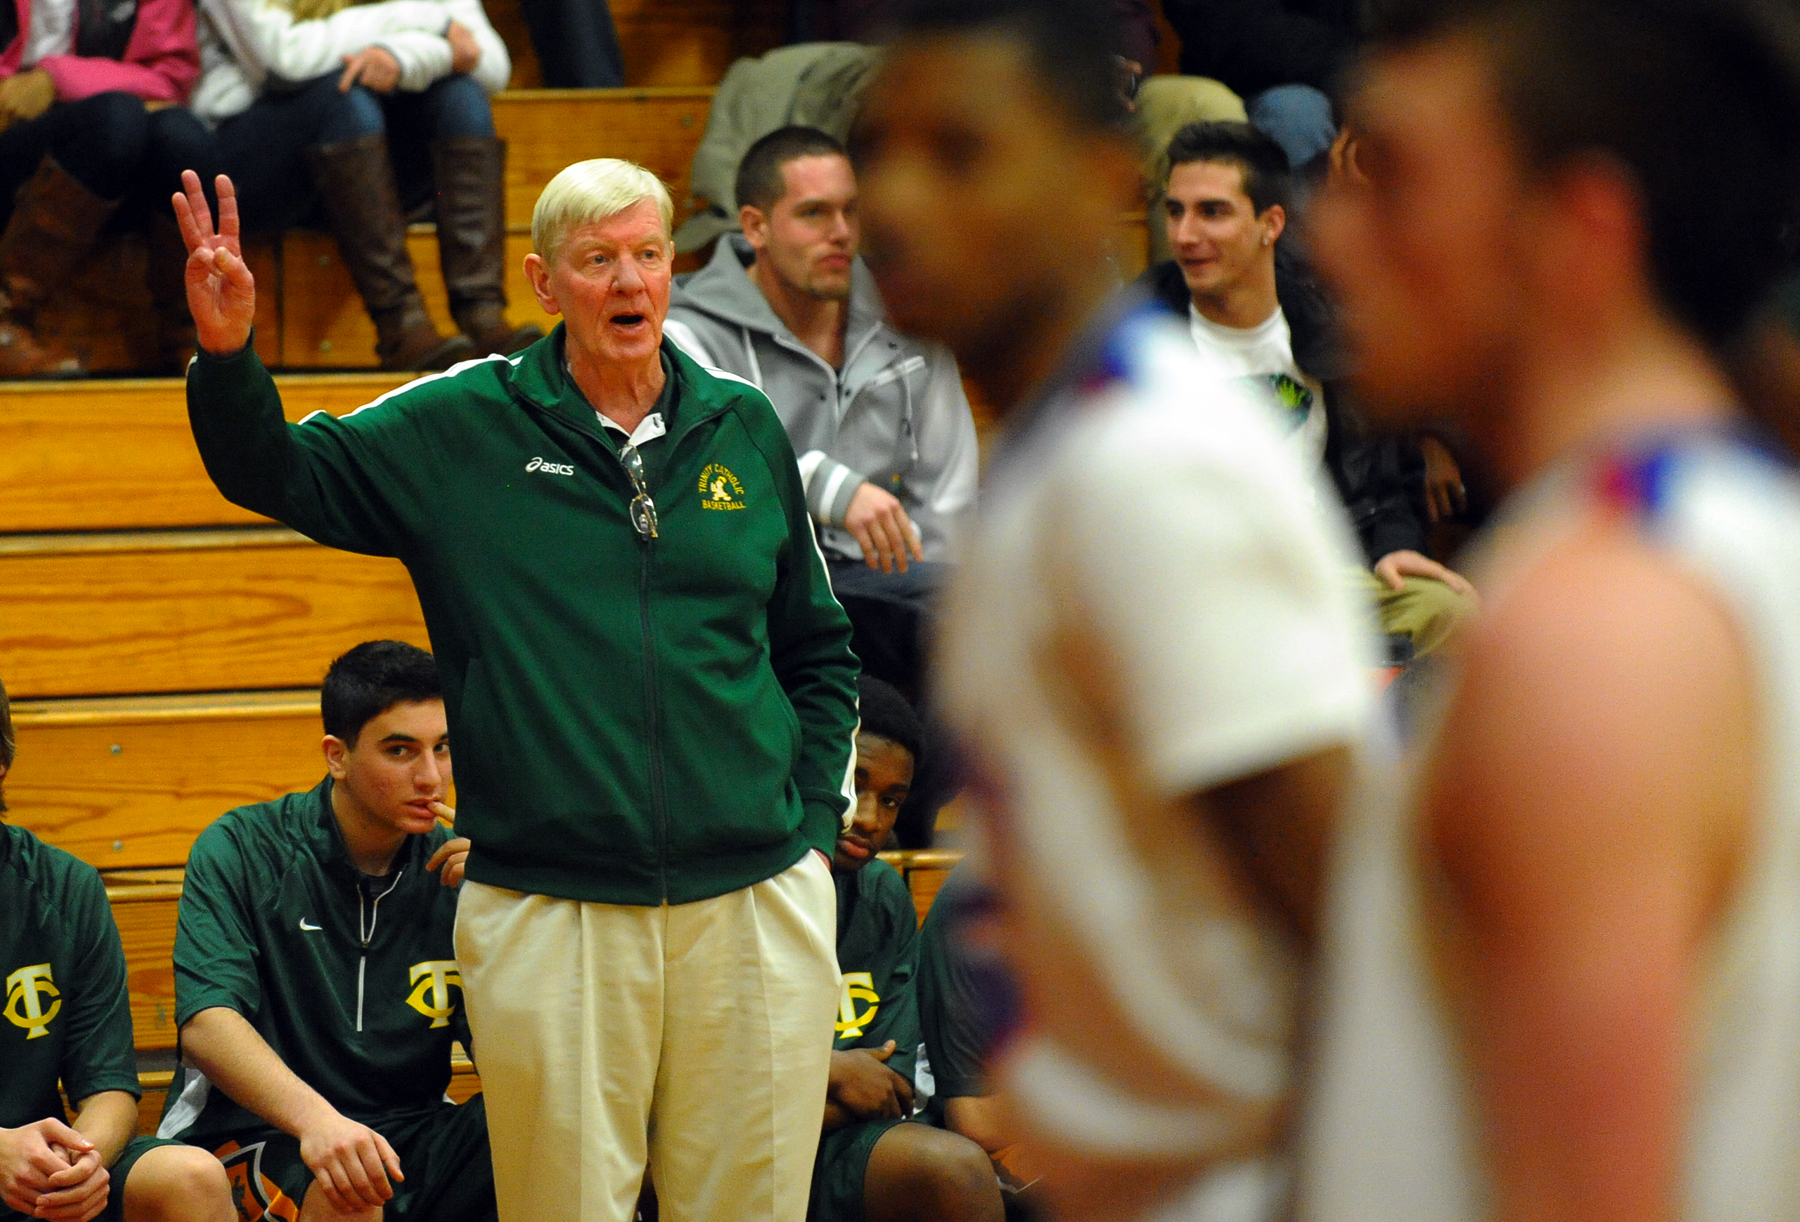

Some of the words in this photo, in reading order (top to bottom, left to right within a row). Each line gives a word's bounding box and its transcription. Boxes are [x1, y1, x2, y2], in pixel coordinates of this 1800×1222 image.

[540, 461, 575, 476] asics
[698, 463, 713, 493] TRINITY
[714, 463, 745, 495] CATHOLIC
[702, 499, 747, 511] BASKETBALL
